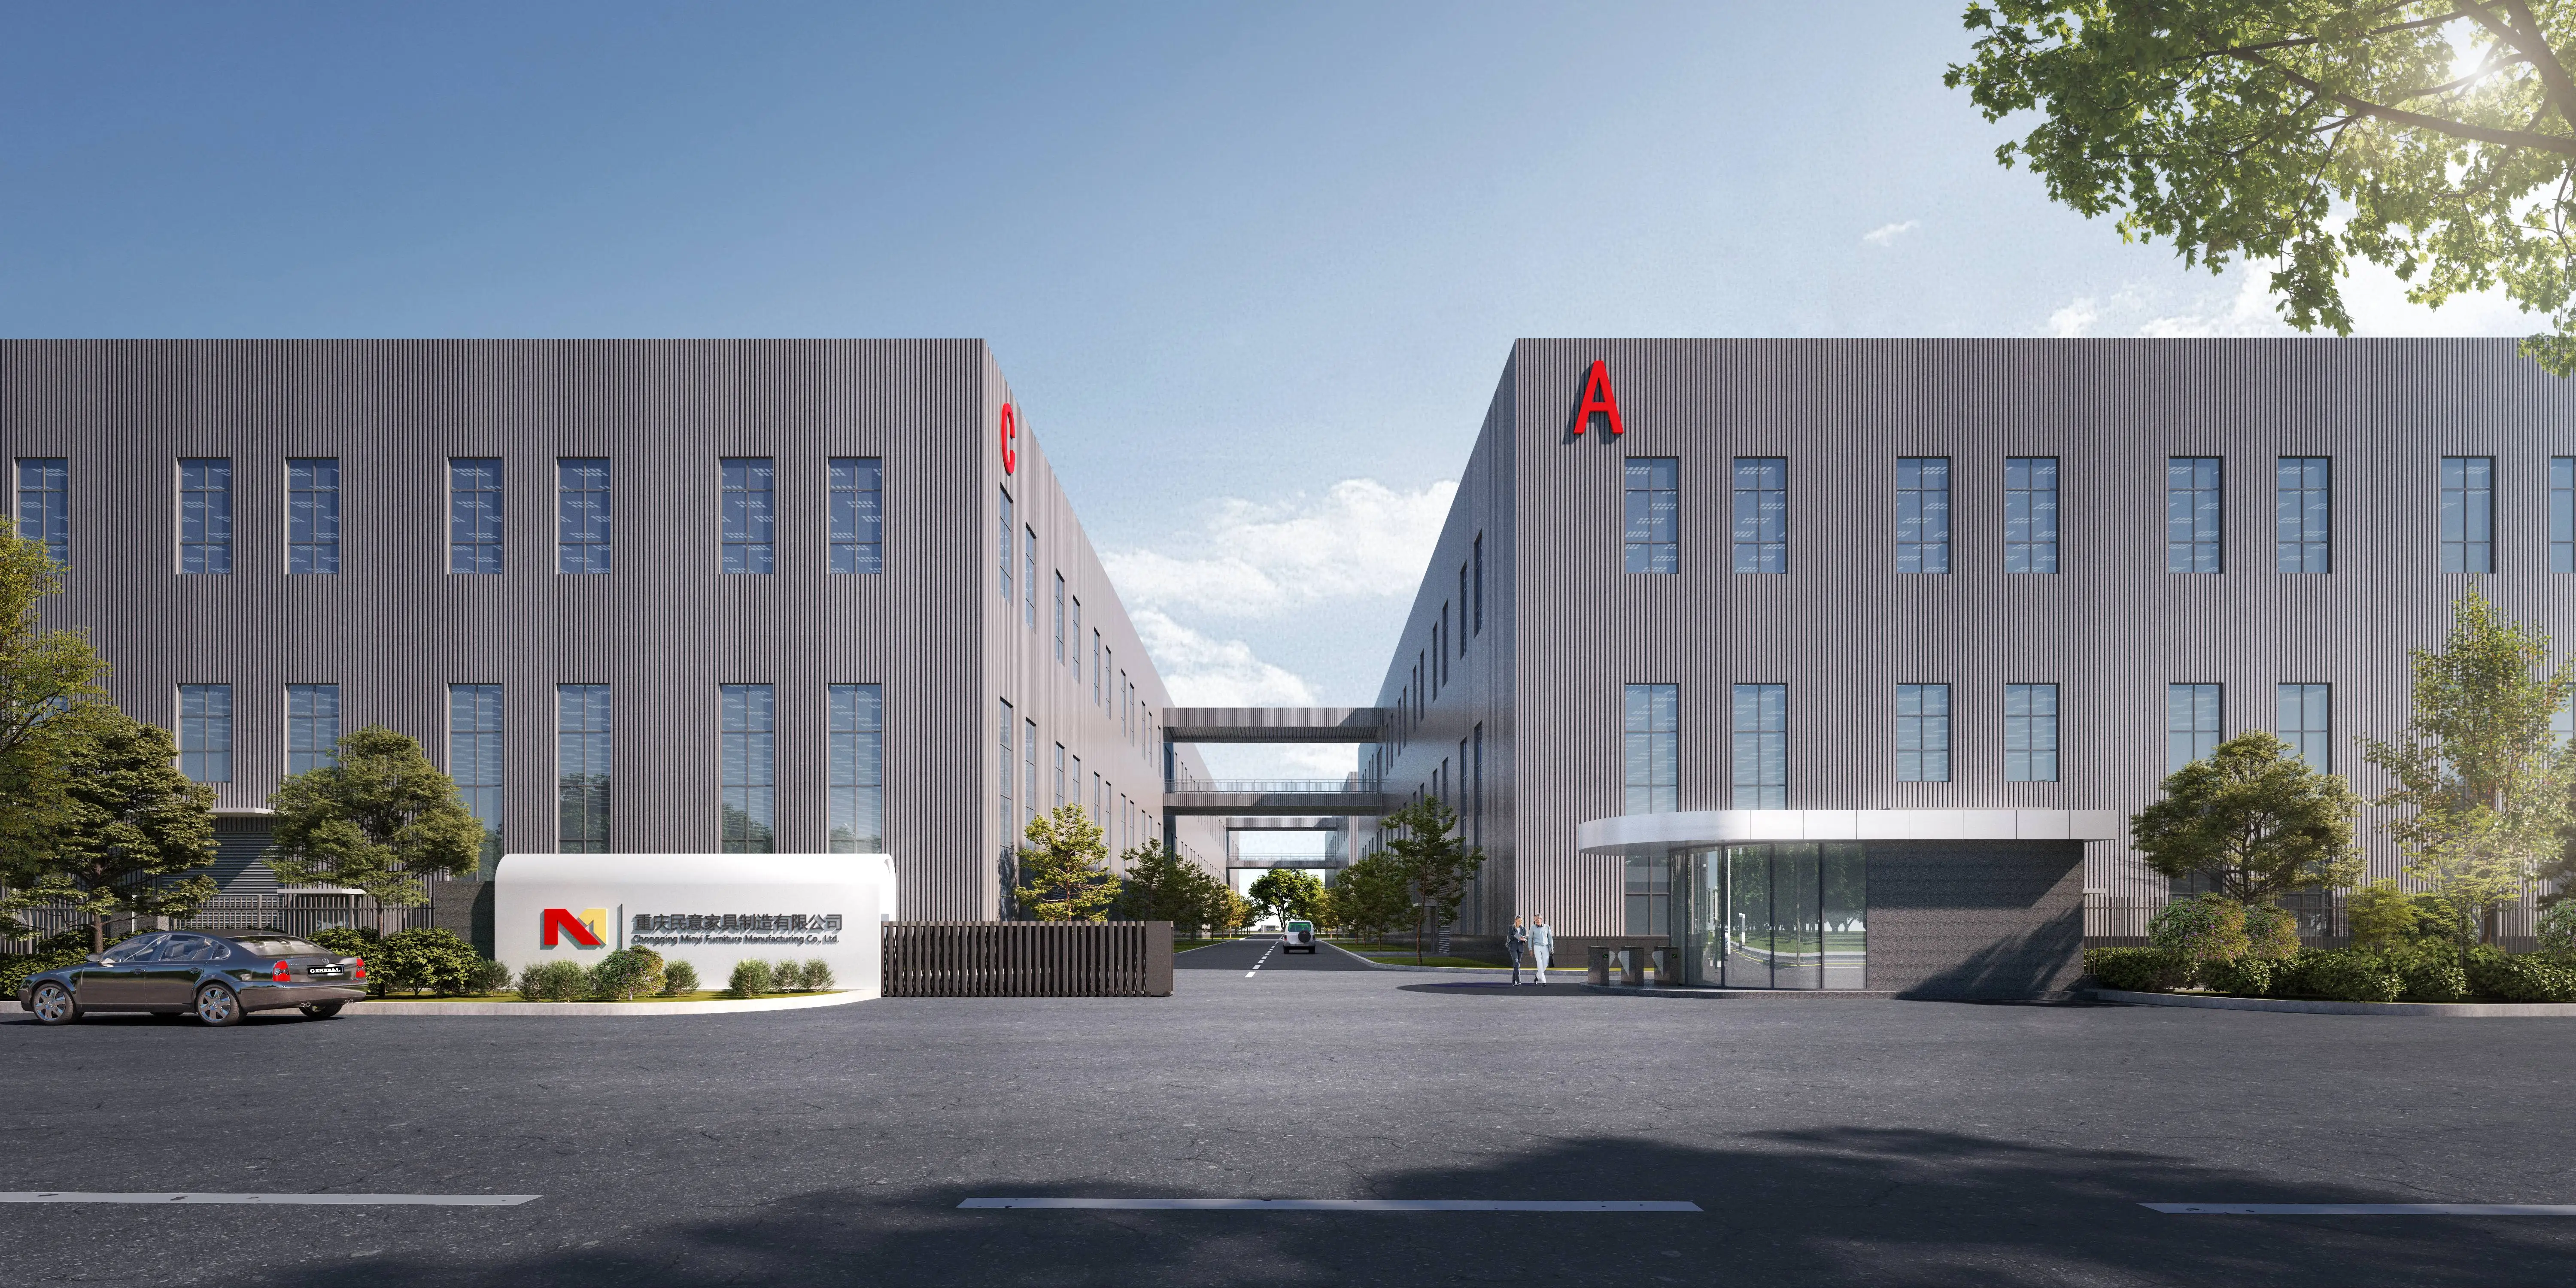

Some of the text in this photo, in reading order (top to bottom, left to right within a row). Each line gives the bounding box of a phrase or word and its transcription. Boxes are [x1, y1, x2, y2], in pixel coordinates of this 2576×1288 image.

[1573, 360, 1624, 434] A
[1001, 403, 1015, 474] C
[633, 914, 842, 930] 重庆民意家具制造有限公司
[633, 934, 678, 944] Chongqing
[681, 935, 703, 944] Minyi
[744, 935, 804, 944] Manufacturing
[807, 935, 822, 943] Co.,
